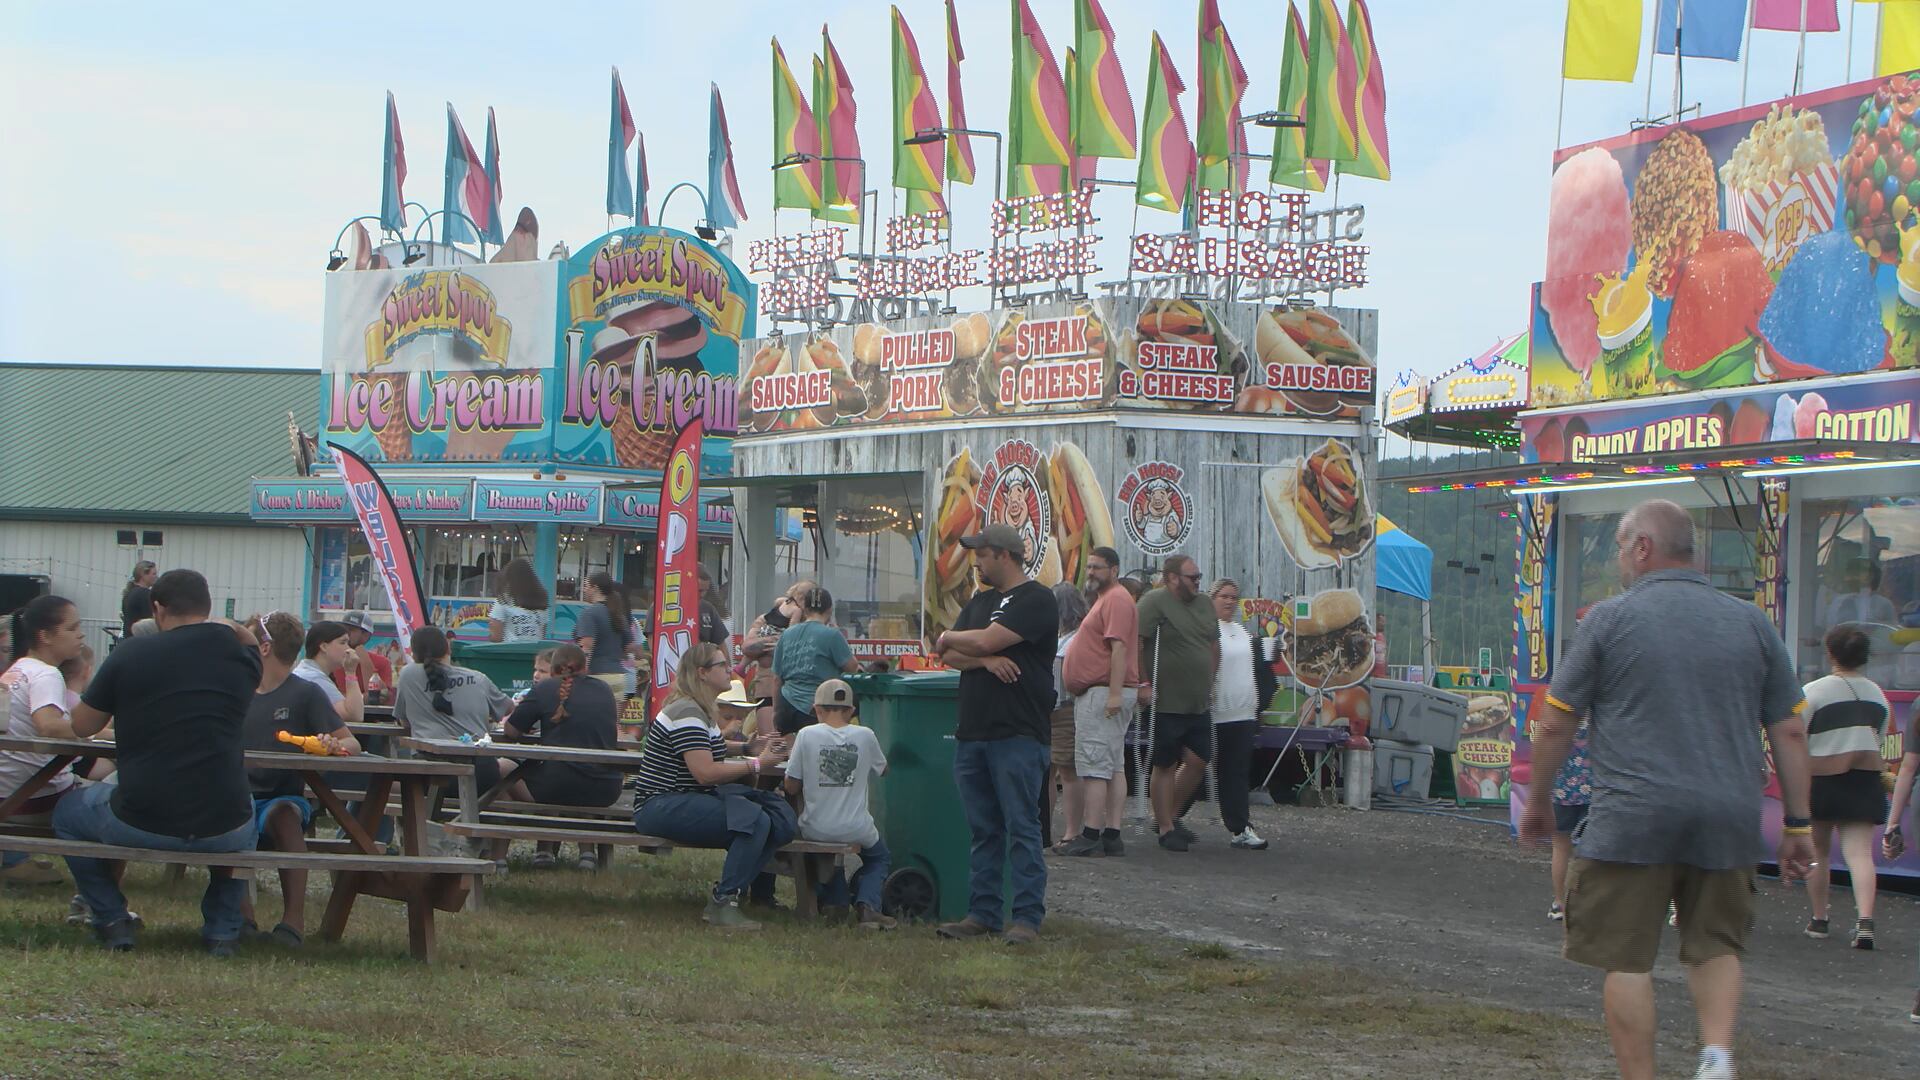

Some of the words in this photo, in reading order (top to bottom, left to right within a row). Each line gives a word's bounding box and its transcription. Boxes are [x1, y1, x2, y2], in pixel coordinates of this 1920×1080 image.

[991, 187, 1094, 237] STEAK
[1199, 188, 1310, 231] HOT
[1775, 199, 1804, 257] POP
[750, 227, 844, 274] PULLED
[886, 210, 944, 252] HOT
[593, 237, 666, 302] Sweet
[671, 237, 726, 311] Spot
[856, 250, 977, 299] SAUSAGE
[1132, 233, 1371, 283] SAUSAGE
[383, 271, 442, 345] Sweet
[447, 268, 493, 338] Spot
[761, 273, 829, 315] PORK
[882, 330, 955, 369] PULLED
[1017, 318, 1087, 360] STEAK
[1139, 342, 1217, 371] STEAK
[561, 329, 621, 428] Ice
[631, 331, 739, 438] Cream
[752, 371, 831, 410] SAUSAGE
[891, 374, 943, 411] PORK
[1001, 368, 1014, 404] &
[1019, 360, 1102, 403] CHEESE
[1121, 371, 1136, 398] &
[1143, 373, 1233, 401] CHEESE
[1267, 364, 1370, 391] SAUSAGE
[327, 366, 393, 432] Ice
[404, 366, 544, 433] Cream
[1572, 430, 1638, 461] CANDY
[1643, 417, 1721, 452] APPLES
[1816, 403, 1910, 441] COTTON
[976, 461, 997, 508] BIG
[995, 440, 1040, 473] HOGS!
[1118, 474, 1140, 503] BIG
[1138, 462, 1184, 483] HOGS!
[261, 489, 291, 512] Cones
[295, 489, 304, 511] &
[307, 488, 343, 511] Dishes
[414, 489, 424, 511] &
[425, 487, 463, 511] Shakes
[487, 490, 543, 509] Banana
[545, 490, 590, 516] Splits
[622, 495, 659, 518] Con
[1034, 545, 1047, 575] STEAK
[1042, 494, 1051, 533] CHEESE
[656, 449, 694, 687] OPEN
[1530, 492, 1545, 678] LEMONADE
[850, 644, 875, 655] TEAK
[884, 644, 919, 656] CHEESE
[1460, 742, 1497, 753] STEAK
[1500, 745, 1509, 753] &
[1464, 752, 1509, 763] CHEESE
